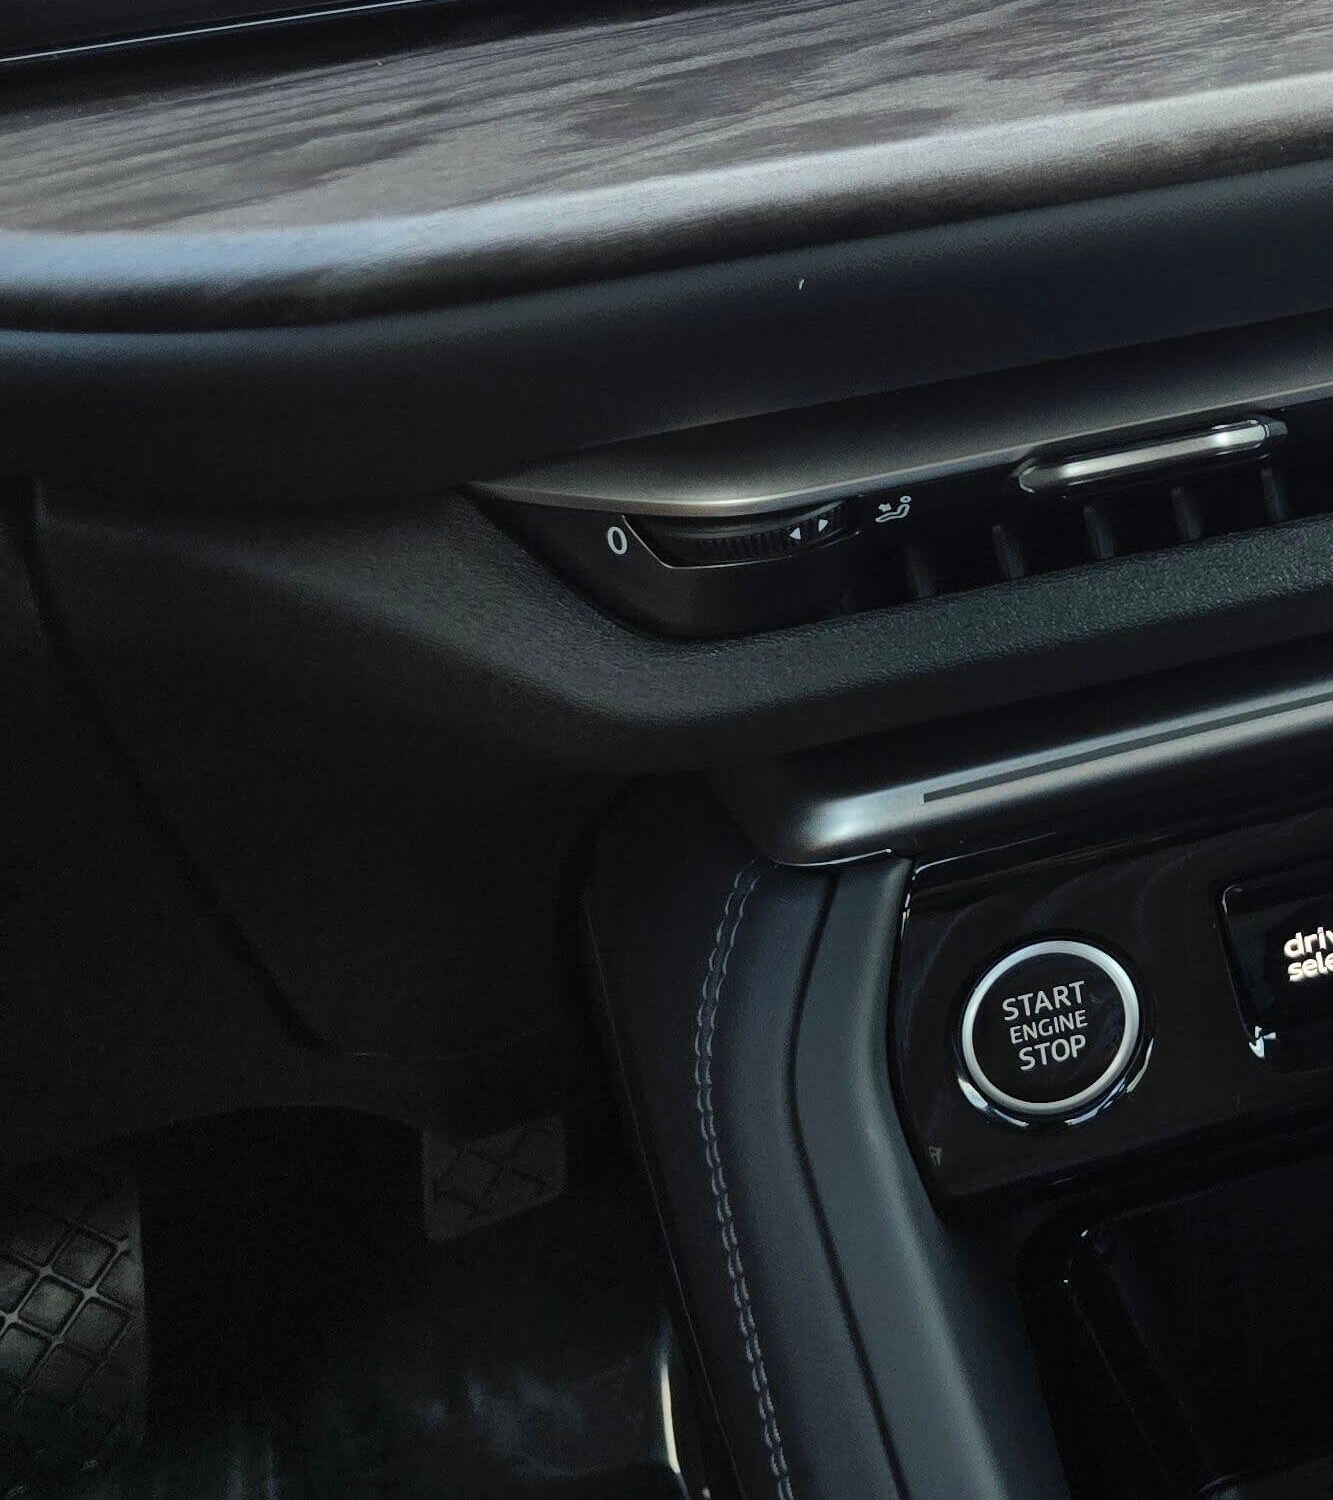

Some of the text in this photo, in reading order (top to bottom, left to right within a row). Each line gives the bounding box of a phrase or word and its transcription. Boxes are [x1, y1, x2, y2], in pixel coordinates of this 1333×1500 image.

[1002, 980, 1085, 1021] START
[1009, 1009, 1089, 1045] ENGINE
[1018, 1034, 1087, 1071] STOP
